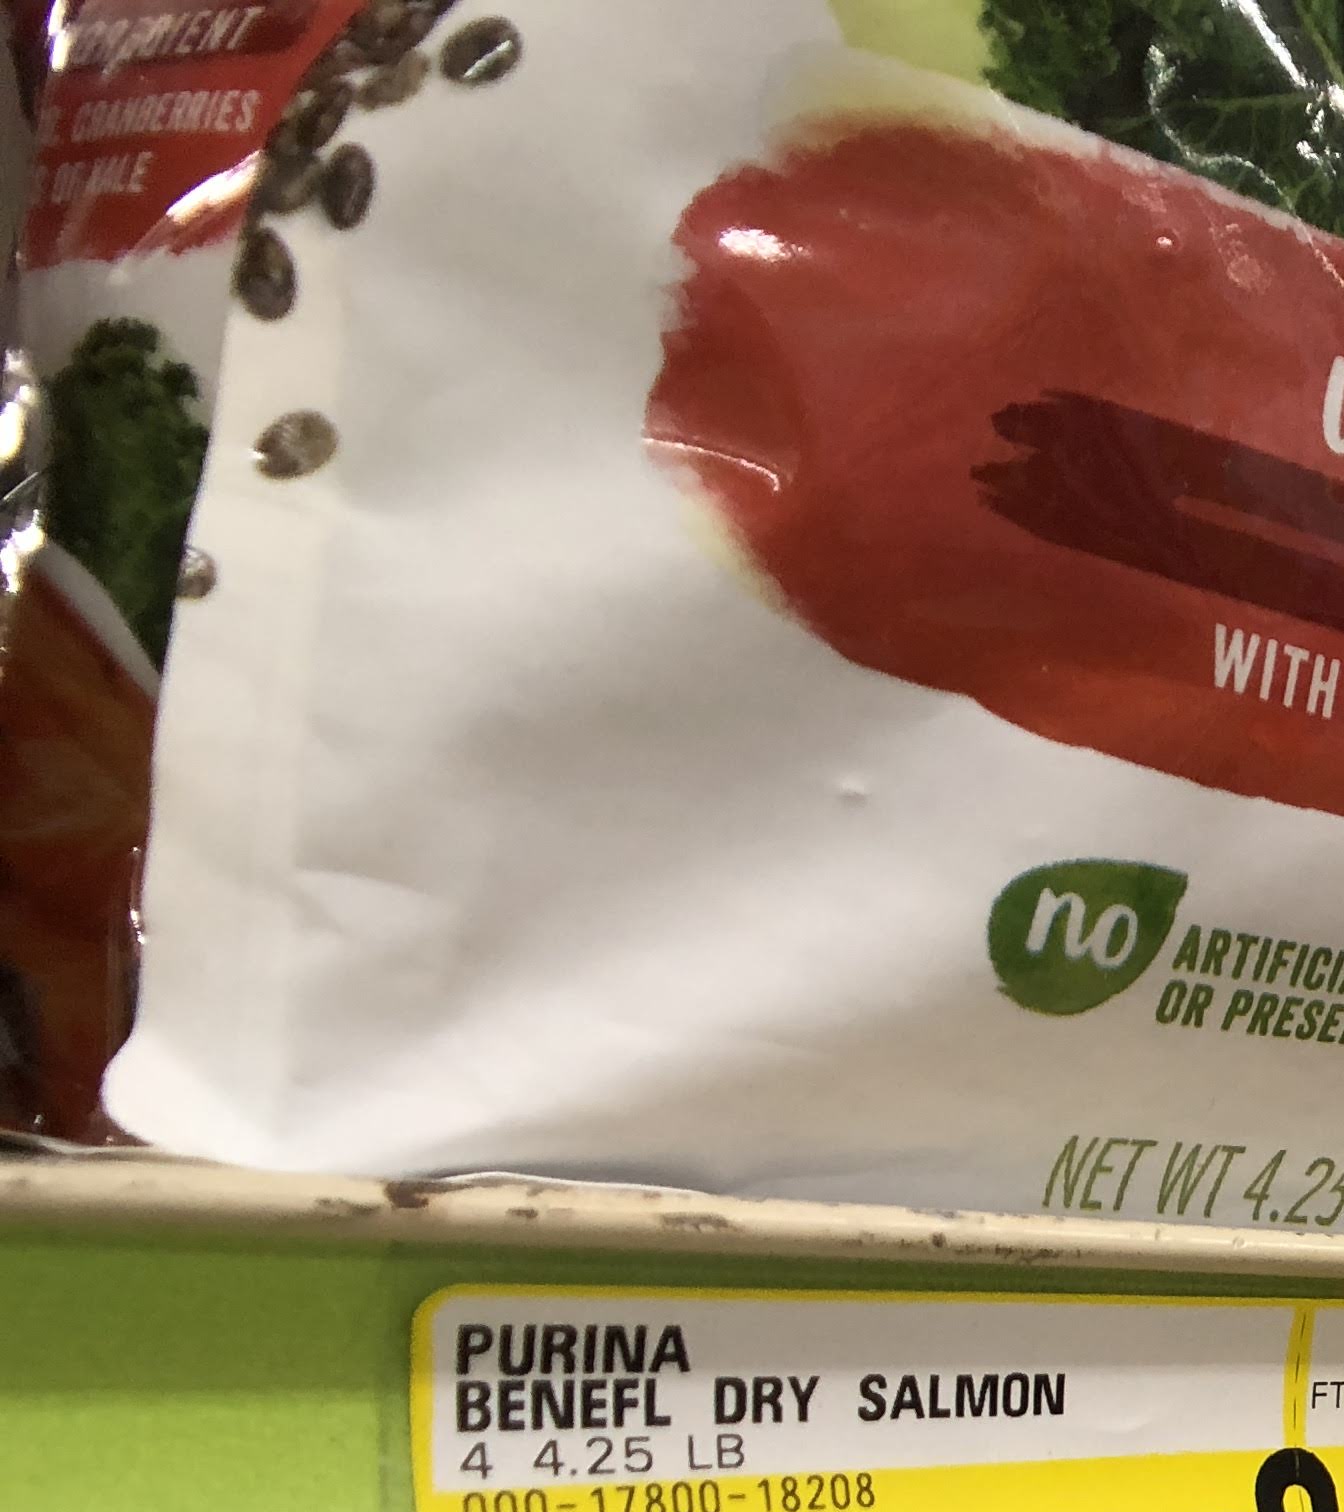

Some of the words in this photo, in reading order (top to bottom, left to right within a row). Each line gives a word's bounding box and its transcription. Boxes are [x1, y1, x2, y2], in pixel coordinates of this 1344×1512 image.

[1214, 623, 1340, 719] WITH
[1024, 887, 1139, 969] no
[1155, 979, 1215, 1029] OR
[1042, 1135, 1157, 1211] NET
[1156, 1141, 1245, 1219] WT
[455, 1324, 691, 1377] PURINA
[455, 1378, 672, 1433] BENEFL
[713, 1375, 820, 1425] DRY
[857, 1372, 1066, 1422] SALMON
[460, 1442, 494, 1479] 4
[533, 1436, 655, 1477] 4.25
[687, 1433, 747, 1471] LB
